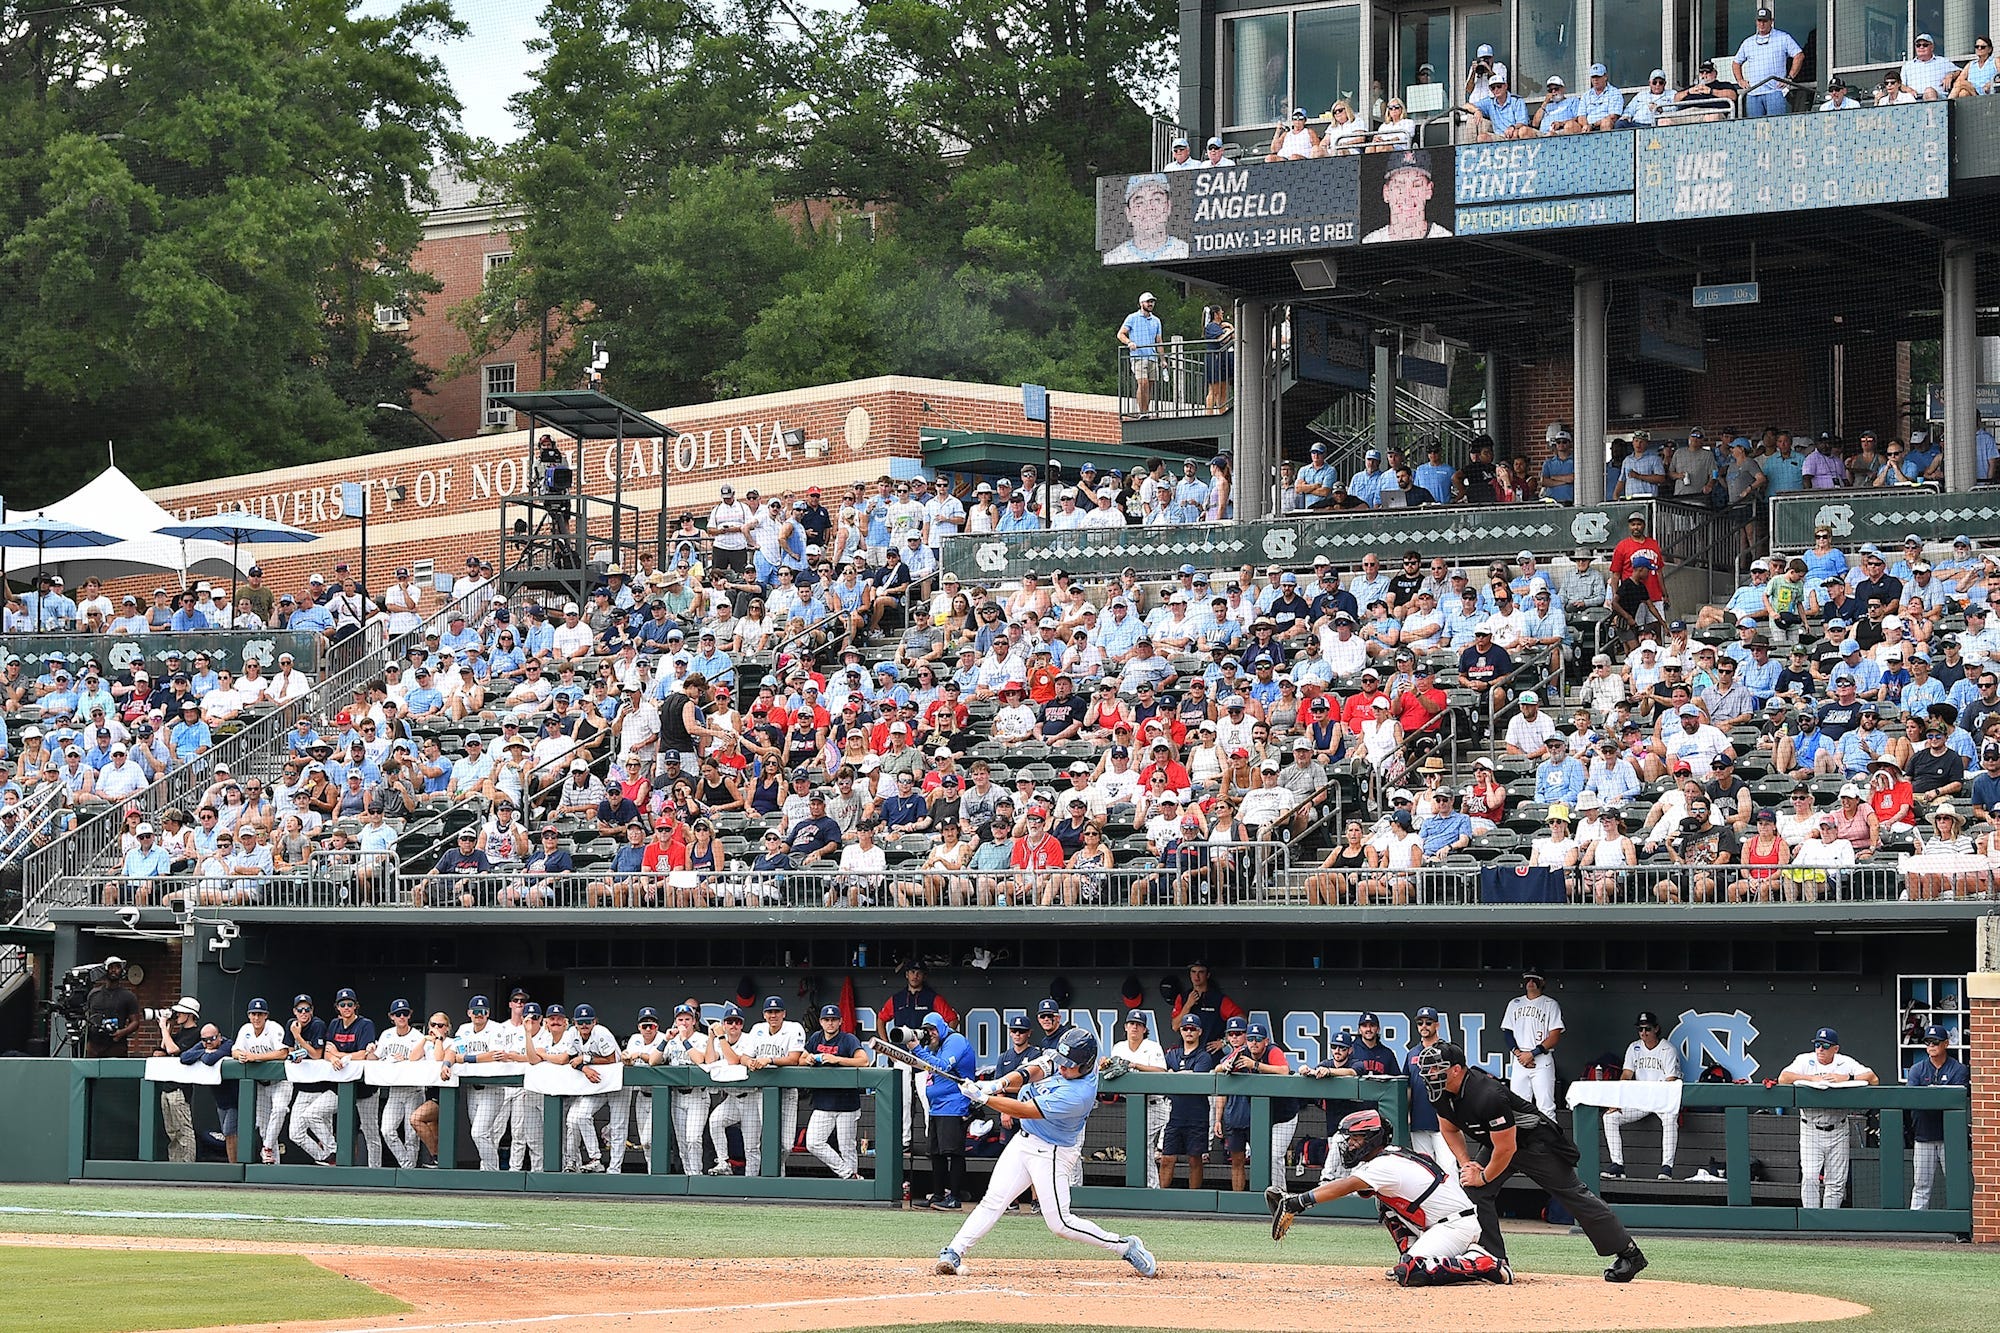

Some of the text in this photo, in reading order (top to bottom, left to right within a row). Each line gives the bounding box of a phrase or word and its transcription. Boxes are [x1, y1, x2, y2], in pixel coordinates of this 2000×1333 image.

[1926, 108, 1936, 128] 1
[1460, 142, 1542, 173] CASEY
[1924, 141, 1939, 162] 2
[1675, 150, 1729, 182] UNC
[1194, 169, 1249, 197] SAM
[1460, 169, 1538, 200] HINTZ
[1925, 175, 1939, 195] 2
[1193, 191, 1287, 222] ANGELO
[1674, 181, 1734, 214] ARIZ
[1458, 211, 1514, 230] PITCH
[1194, 222, 1354, 252] TODAY: 1-2 HR, 2 RBI
[415, 467, 453, 508] OF
[470, 447, 588, 501] NOH
[604, 420, 793, 482] CAROLINA
[655, 854, 672, 873] A
[1536, 1031, 1543, 1042] 3
[753, 1043, 785, 1058] ARIZONA
[874, 1041, 914, 1066] LOUISVILLE
